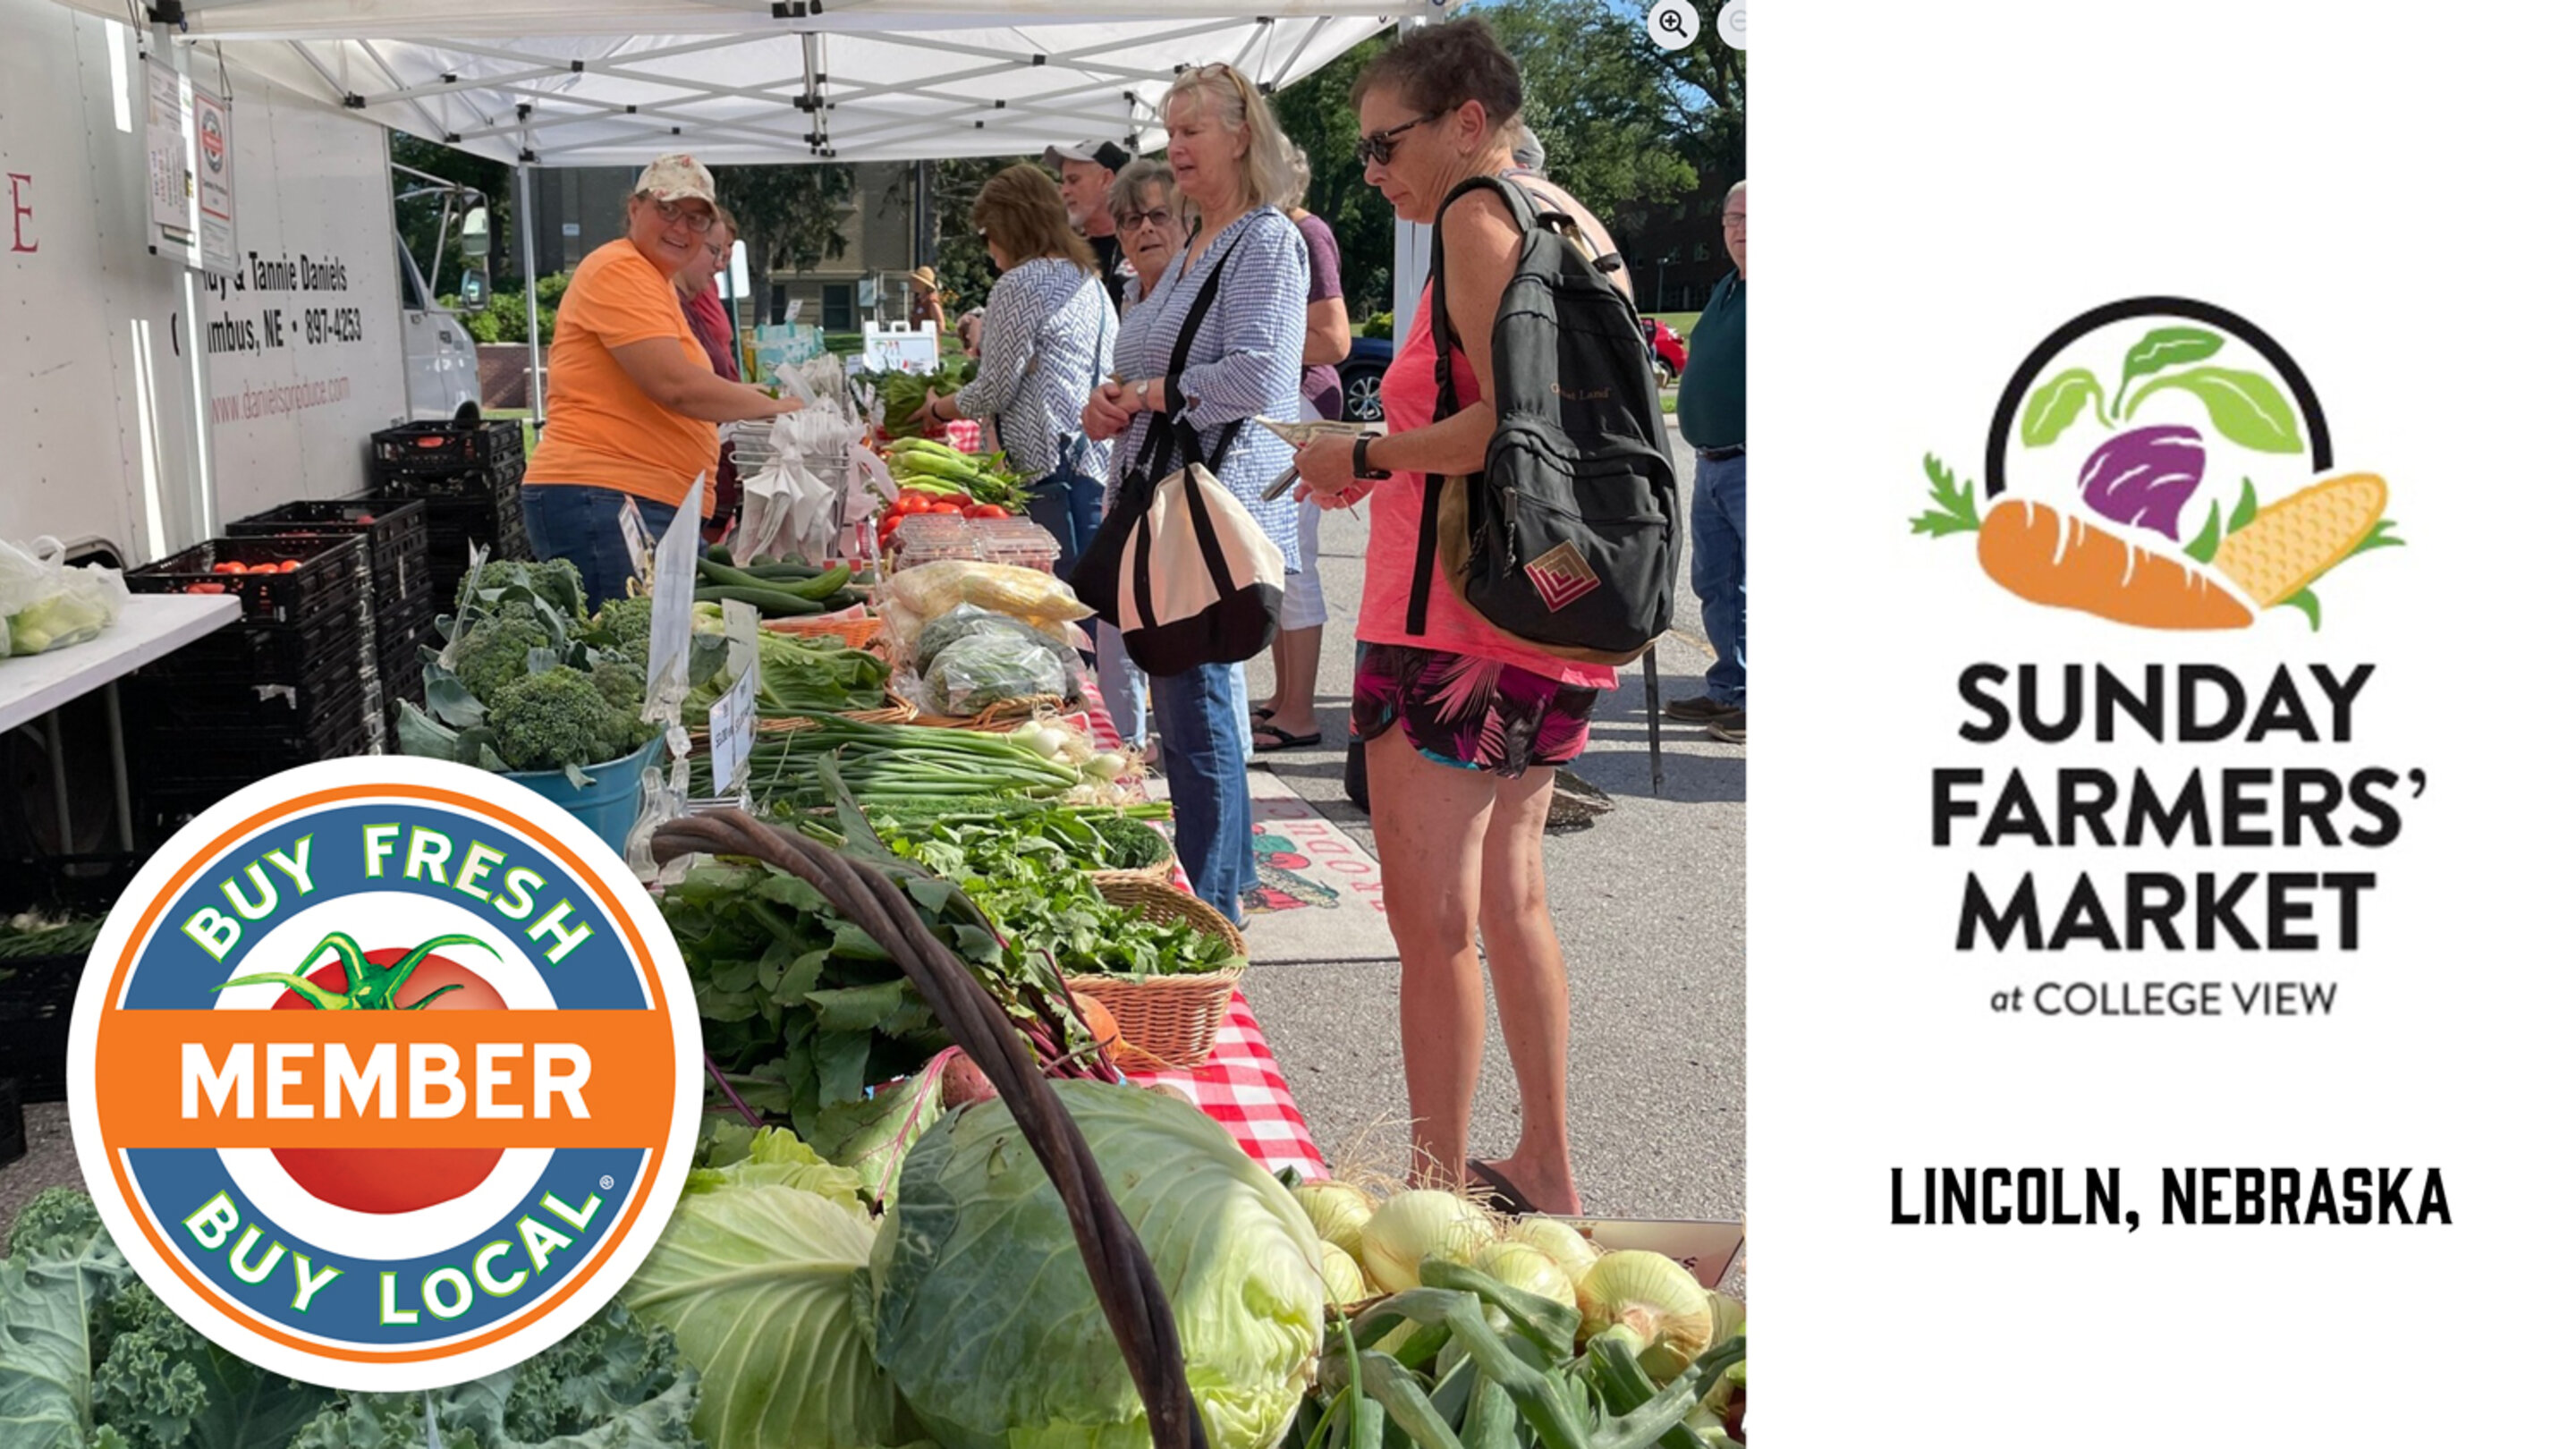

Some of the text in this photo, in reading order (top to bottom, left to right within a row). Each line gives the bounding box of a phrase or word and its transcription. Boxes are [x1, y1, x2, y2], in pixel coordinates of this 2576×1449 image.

[248, 250, 297, 292] Tannie
[300, 253, 348, 292] Daniels
[263, 309, 284, 349] NE
[304, 308, 361, 345] 897-4253
[211, 377, 351, 425] www.danielsproduce.com
